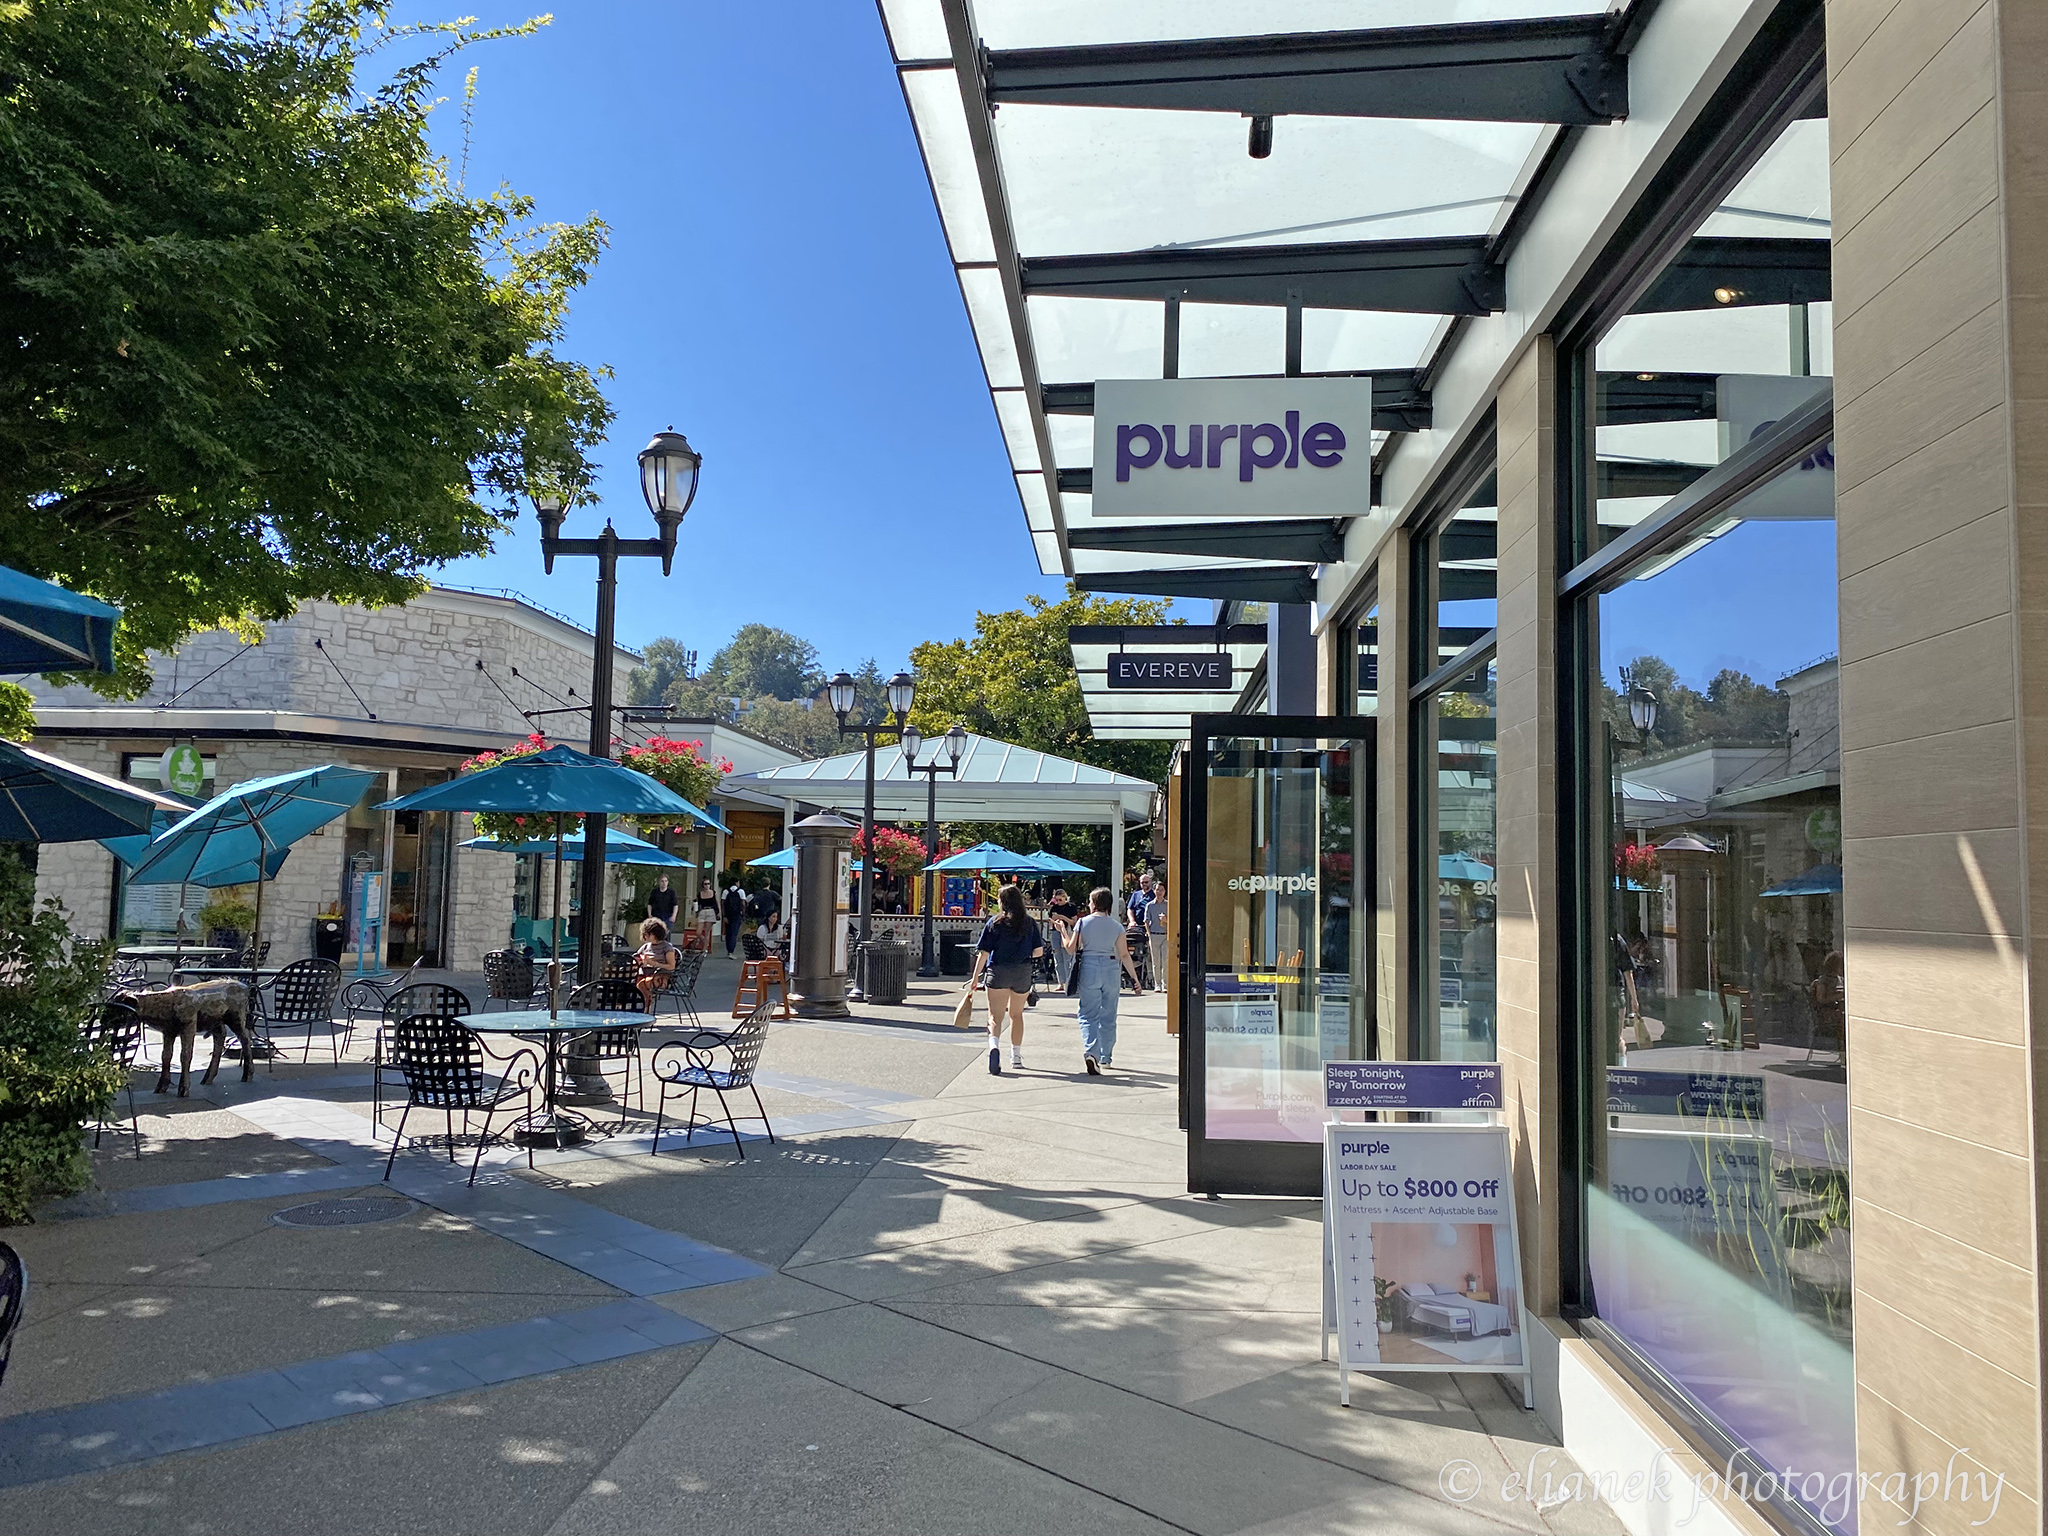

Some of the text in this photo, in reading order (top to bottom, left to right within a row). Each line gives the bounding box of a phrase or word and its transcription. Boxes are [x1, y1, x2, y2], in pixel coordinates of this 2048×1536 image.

[1116, 410, 1346, 482] purple
[1119, 662, 1220, 678] EVEREVE
[1249, 872, 1318, 895] purple
[1327, 1067, 1405, 1080] Sleep Tonight,
[1460, 1068, 1495, 1080] purple
[1328, 1080, 1407, 1092] Pay Tomorrow
[1461, 1092, 1496, 1107] affirm
[1341, 1140, 1390, 1157] purple
[1340, 1163, 1363, 1171] LABOR
[1342, 1178, 1372, 1201] Up
[1376, 1180, 1399, 1197] to
[1404, 1177, 1458, 1200] $800
[1343, 1205, 1382, 1214] Mattress
[1428, 1206, 1475, 1217] Adjustable
[1477, 1206, 1499, 1216] Base
